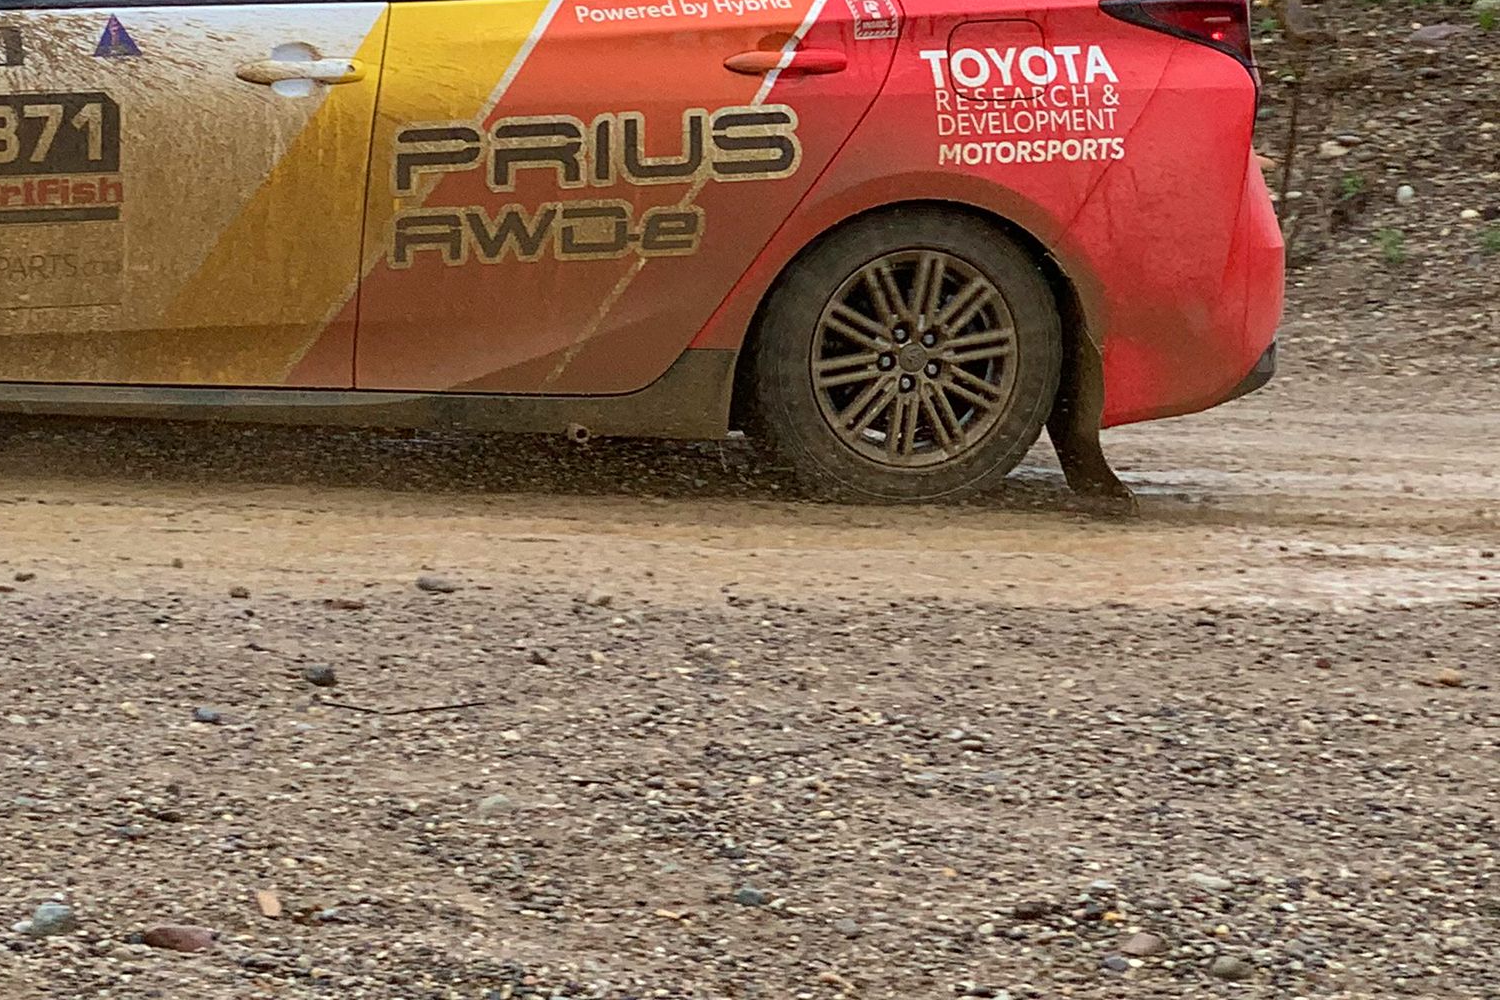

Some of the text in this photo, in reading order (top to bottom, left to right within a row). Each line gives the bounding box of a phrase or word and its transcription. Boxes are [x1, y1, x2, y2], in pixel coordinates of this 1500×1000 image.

[574, 1, 677, 24] Powered
[680, 0, 708, 19] by
[919, 45, 1119, 89] TOYOTA
[935, 84, 1120, 112] RESEARCH &
[937, 108, 1118, 136] DEVELOPMENT
[395, 106, 800, 195] PRIUS
[938, 137, 1125, 166] MOTORSPORTS
